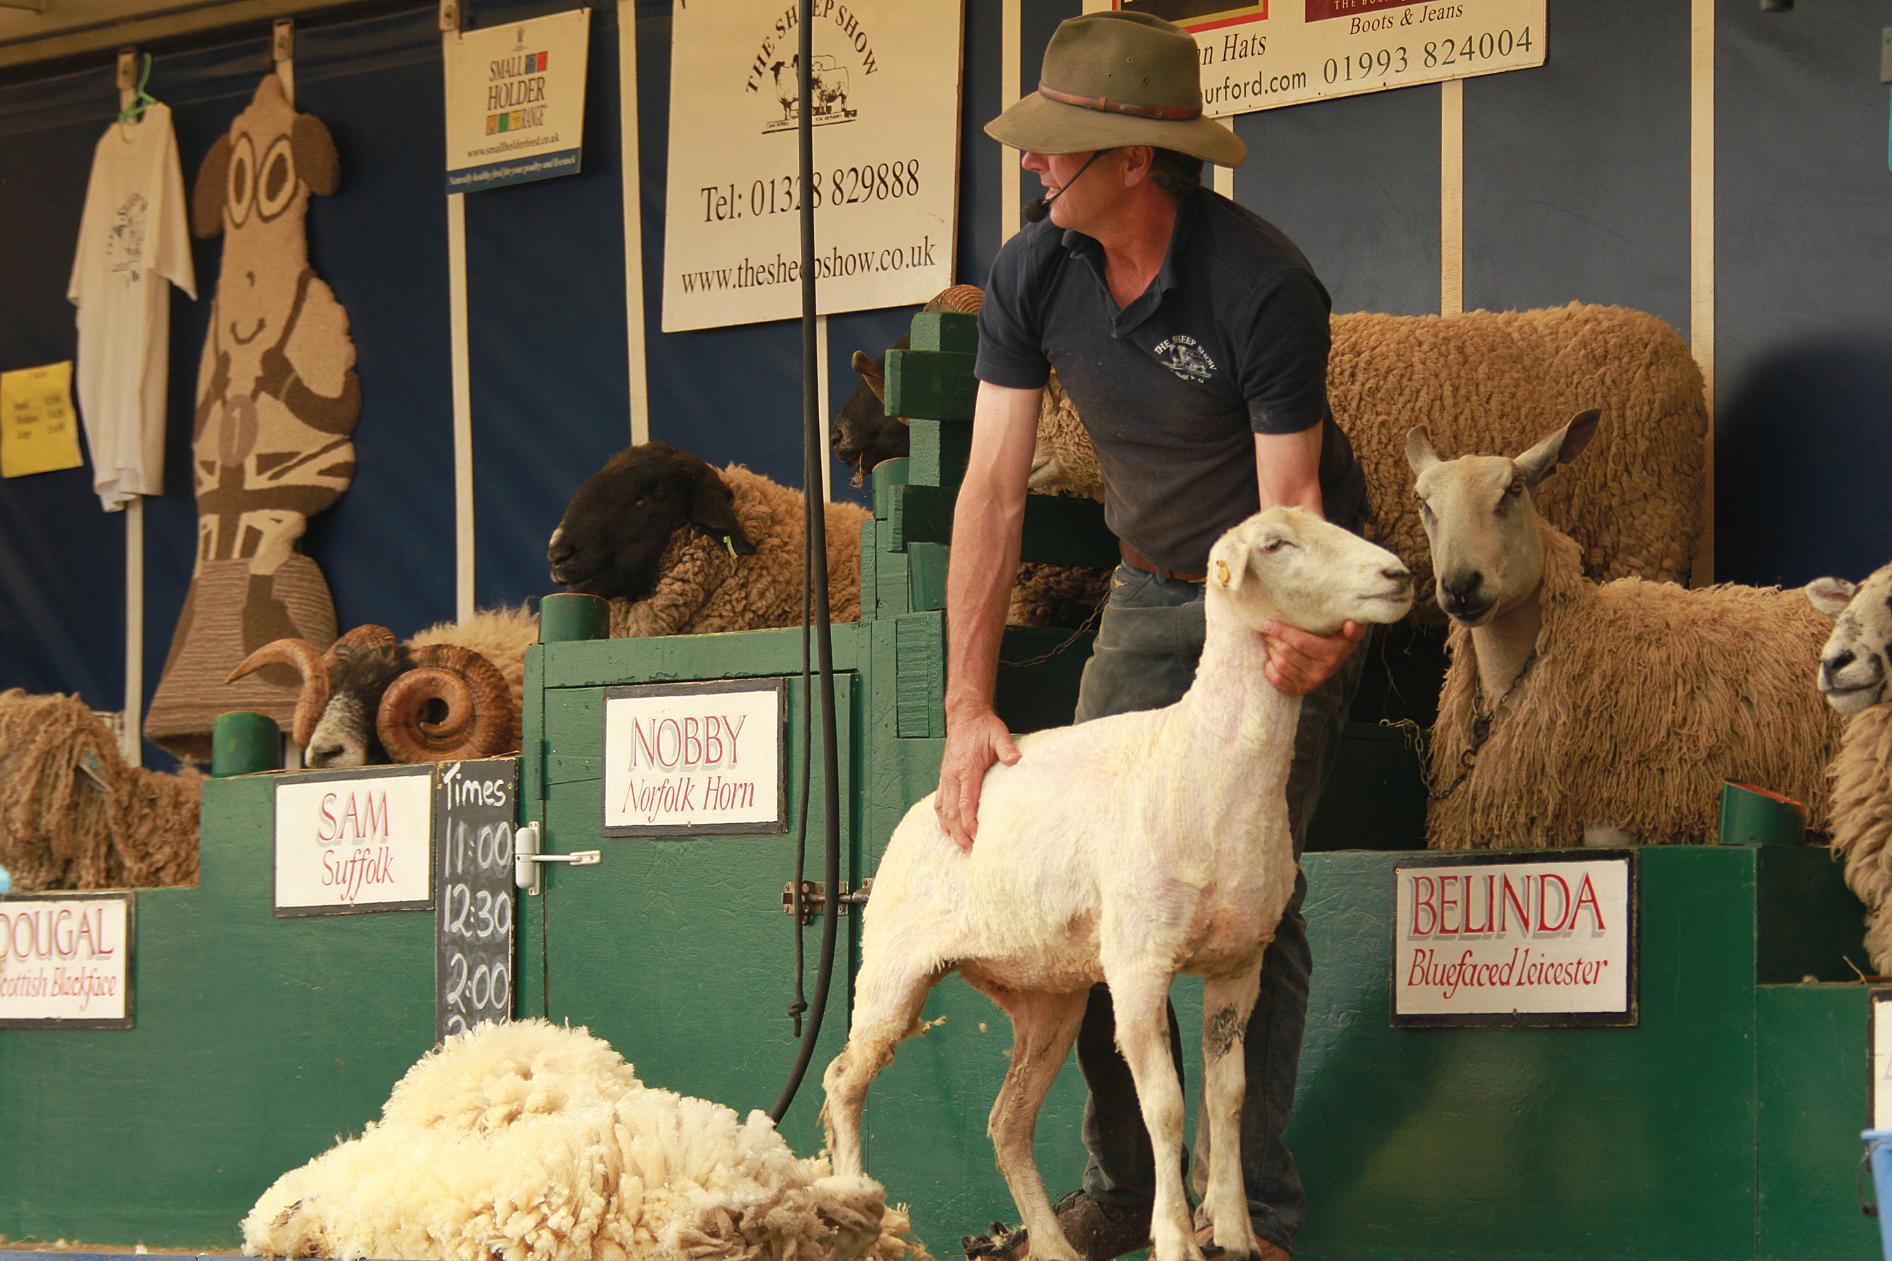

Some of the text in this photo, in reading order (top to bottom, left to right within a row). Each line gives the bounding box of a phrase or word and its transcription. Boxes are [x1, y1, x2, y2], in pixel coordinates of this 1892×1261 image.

[1349, 4, 1463, 35] Boots & Jeans
[490, 56, 523, 82] SMALL
[746, 0, 877, 93] THE SHEP SHOW
[1202, 26, 1532, 105] urford.com 01993 824004
[1221, 33, 1267, 62] Hats
[488, 76, 546, 111] HOLDER
[701, 184, 742, 222] Tel:
[832, 159, 919, 205] 829888
[631, 715, 748, 769] NOBBY
[443, 762, 506, 810] Times
[622, 776, 755, 823] Norfolk Horn
[317, 790, 389, 843] SAM
[321, 847, 394, 900] Suffolk
[445, 817, 512, 878] 11:00
[444, 883, 511, 938] 12:30
[1410, 871, 1606, 936] BELINDA
[0, 966, 116, 1012] cottish Blackface
[447, 953, 509, 1013] 2:00
[1408, 947, 1608, 999] Bluefaced Leicester
